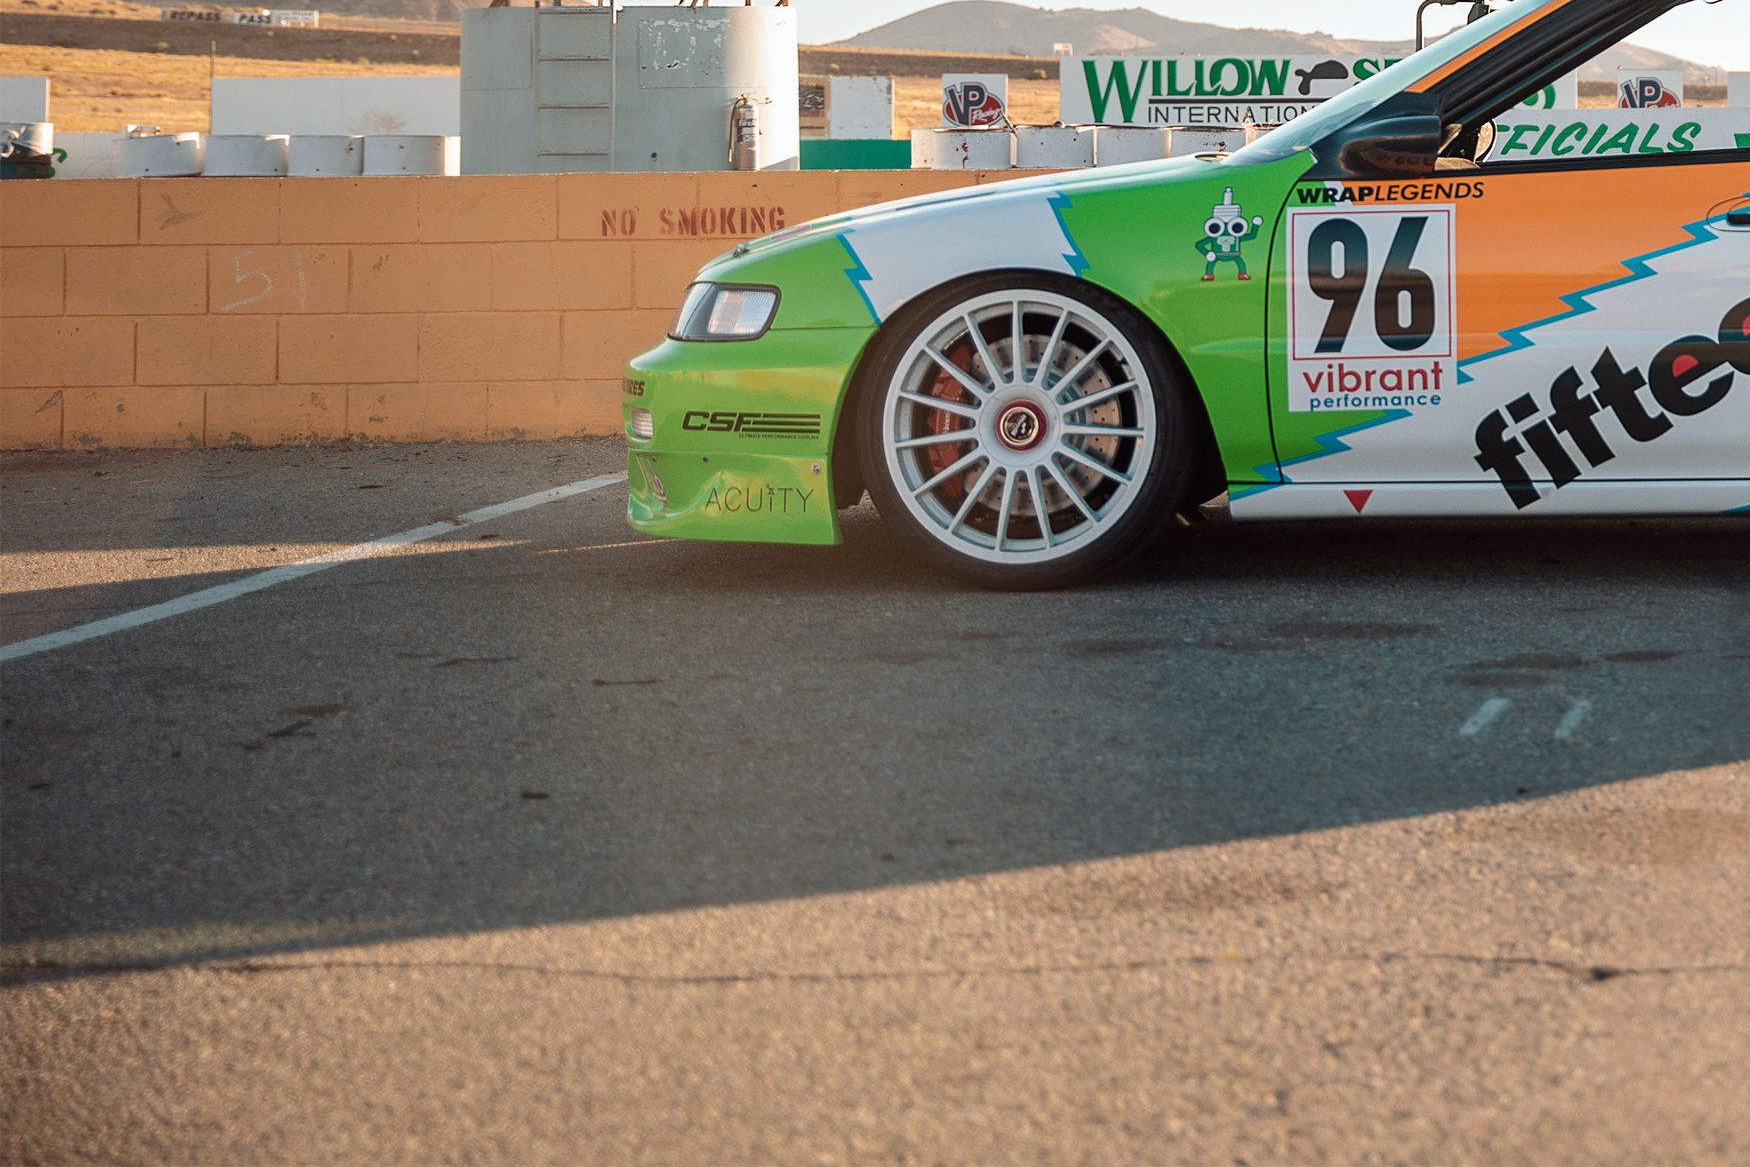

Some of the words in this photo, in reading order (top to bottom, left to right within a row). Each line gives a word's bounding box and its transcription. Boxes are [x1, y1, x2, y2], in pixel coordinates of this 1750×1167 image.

[945, 82, 987, 126] VP
[1081, 57, 1291, 123] WILLOW
[601, 209, 636, 236] NO
[659, 206, 786, 236] SMOKING
[1307, 216, 1436, 354] 96
[1302, 361, 1444, 394] vibrant
[1310, 394, 1442, 412] performance
